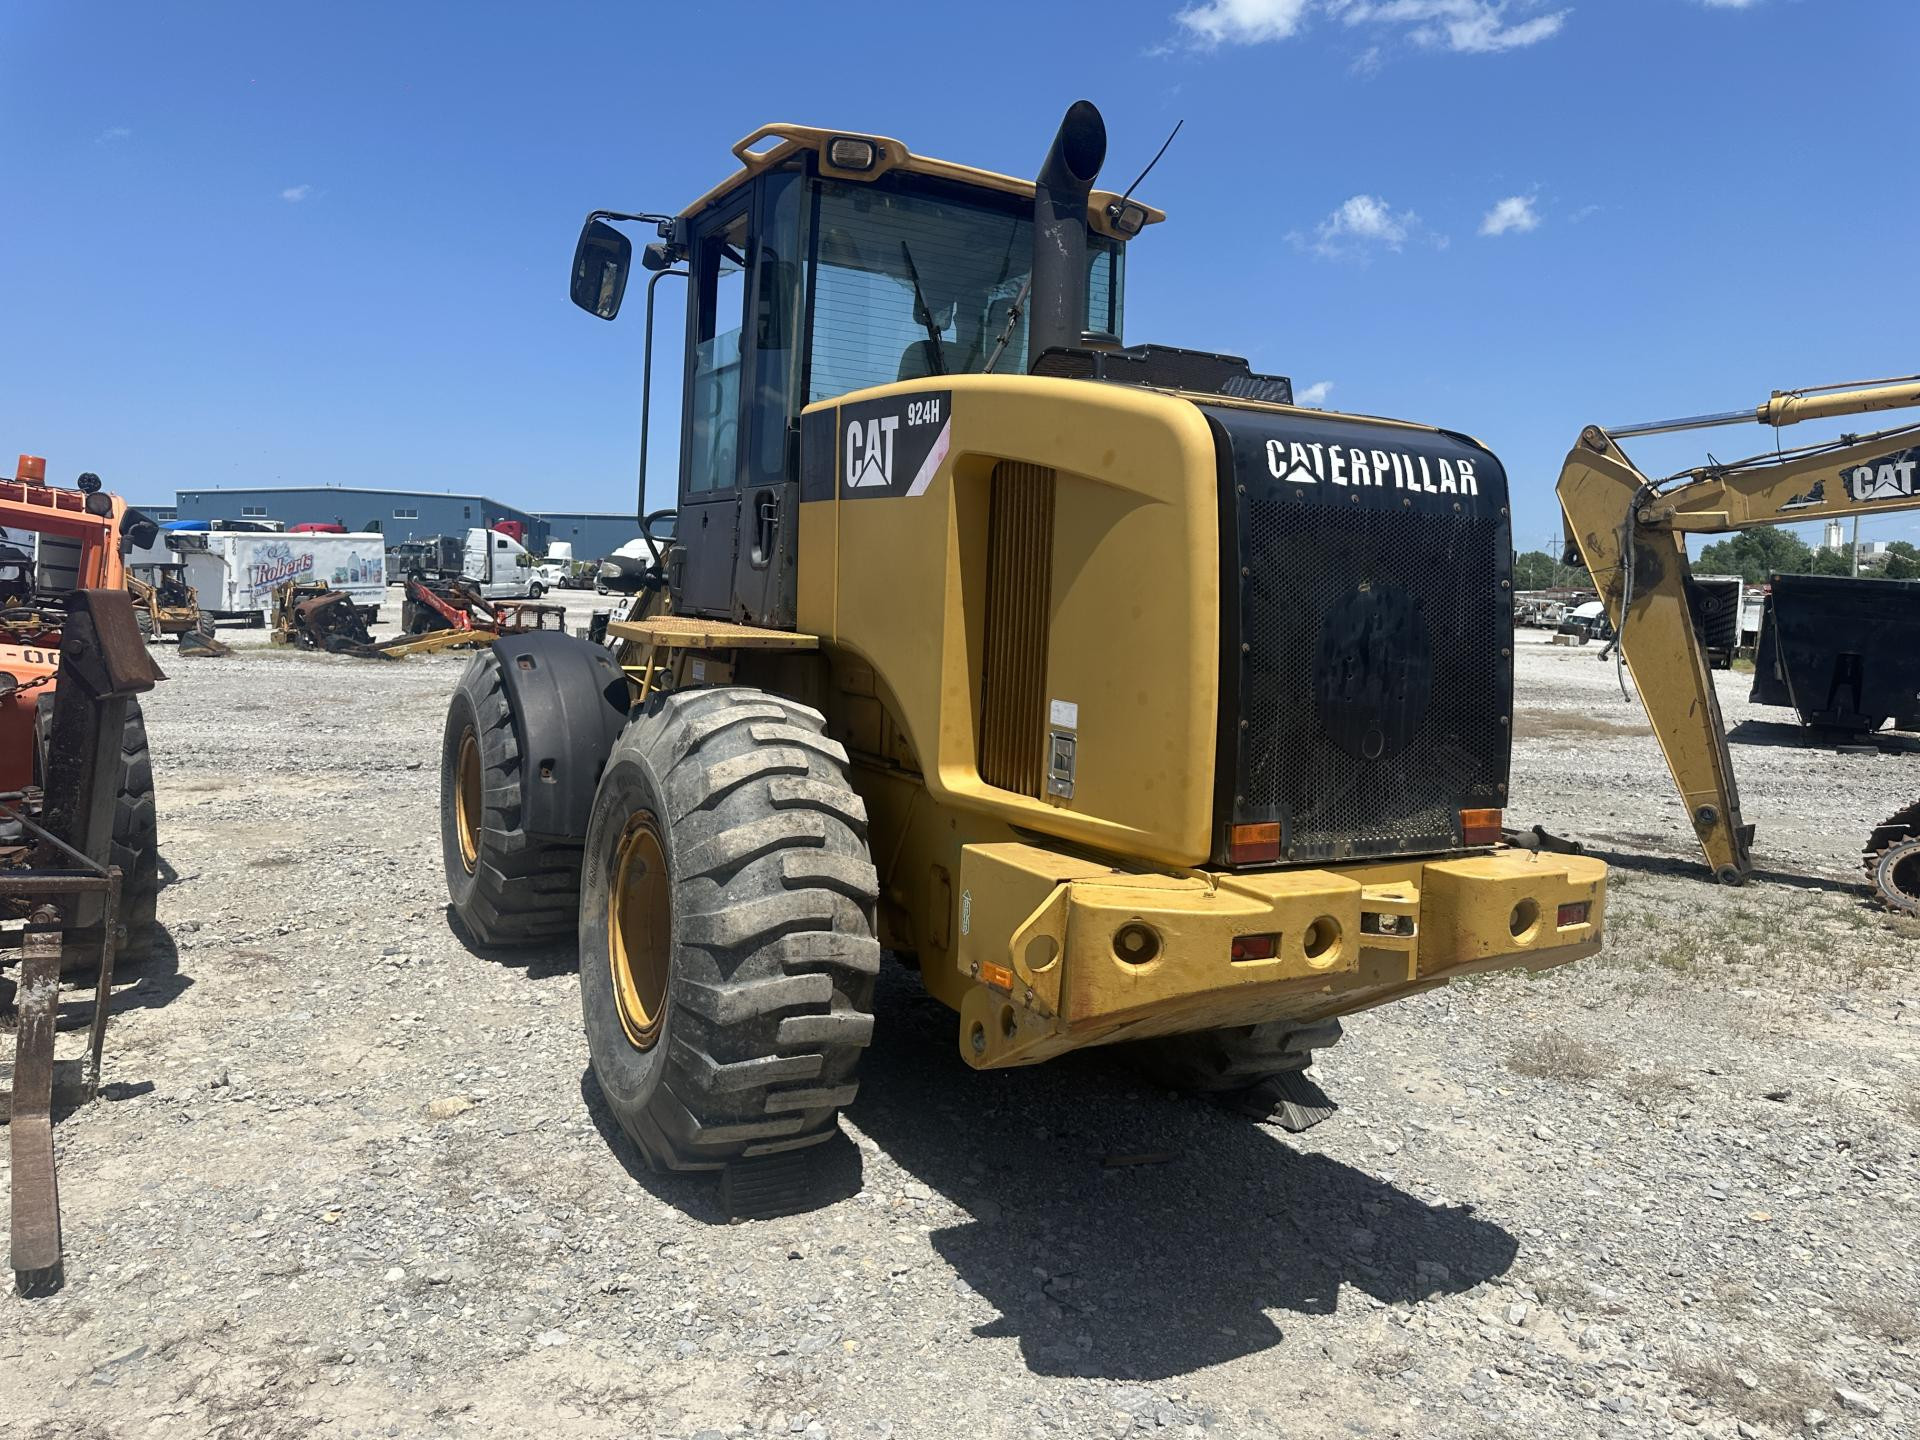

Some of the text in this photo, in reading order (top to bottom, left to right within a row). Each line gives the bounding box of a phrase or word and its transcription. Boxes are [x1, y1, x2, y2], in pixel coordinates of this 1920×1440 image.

[907, 398, 940, 426] 924H
[846, 415, 899, 488] CAT
[1265, 439, 1478, 496] CATERPILLAR
[1852, 461, 1917, 500] CAT
[254, 552, 314, 587] Roberts
